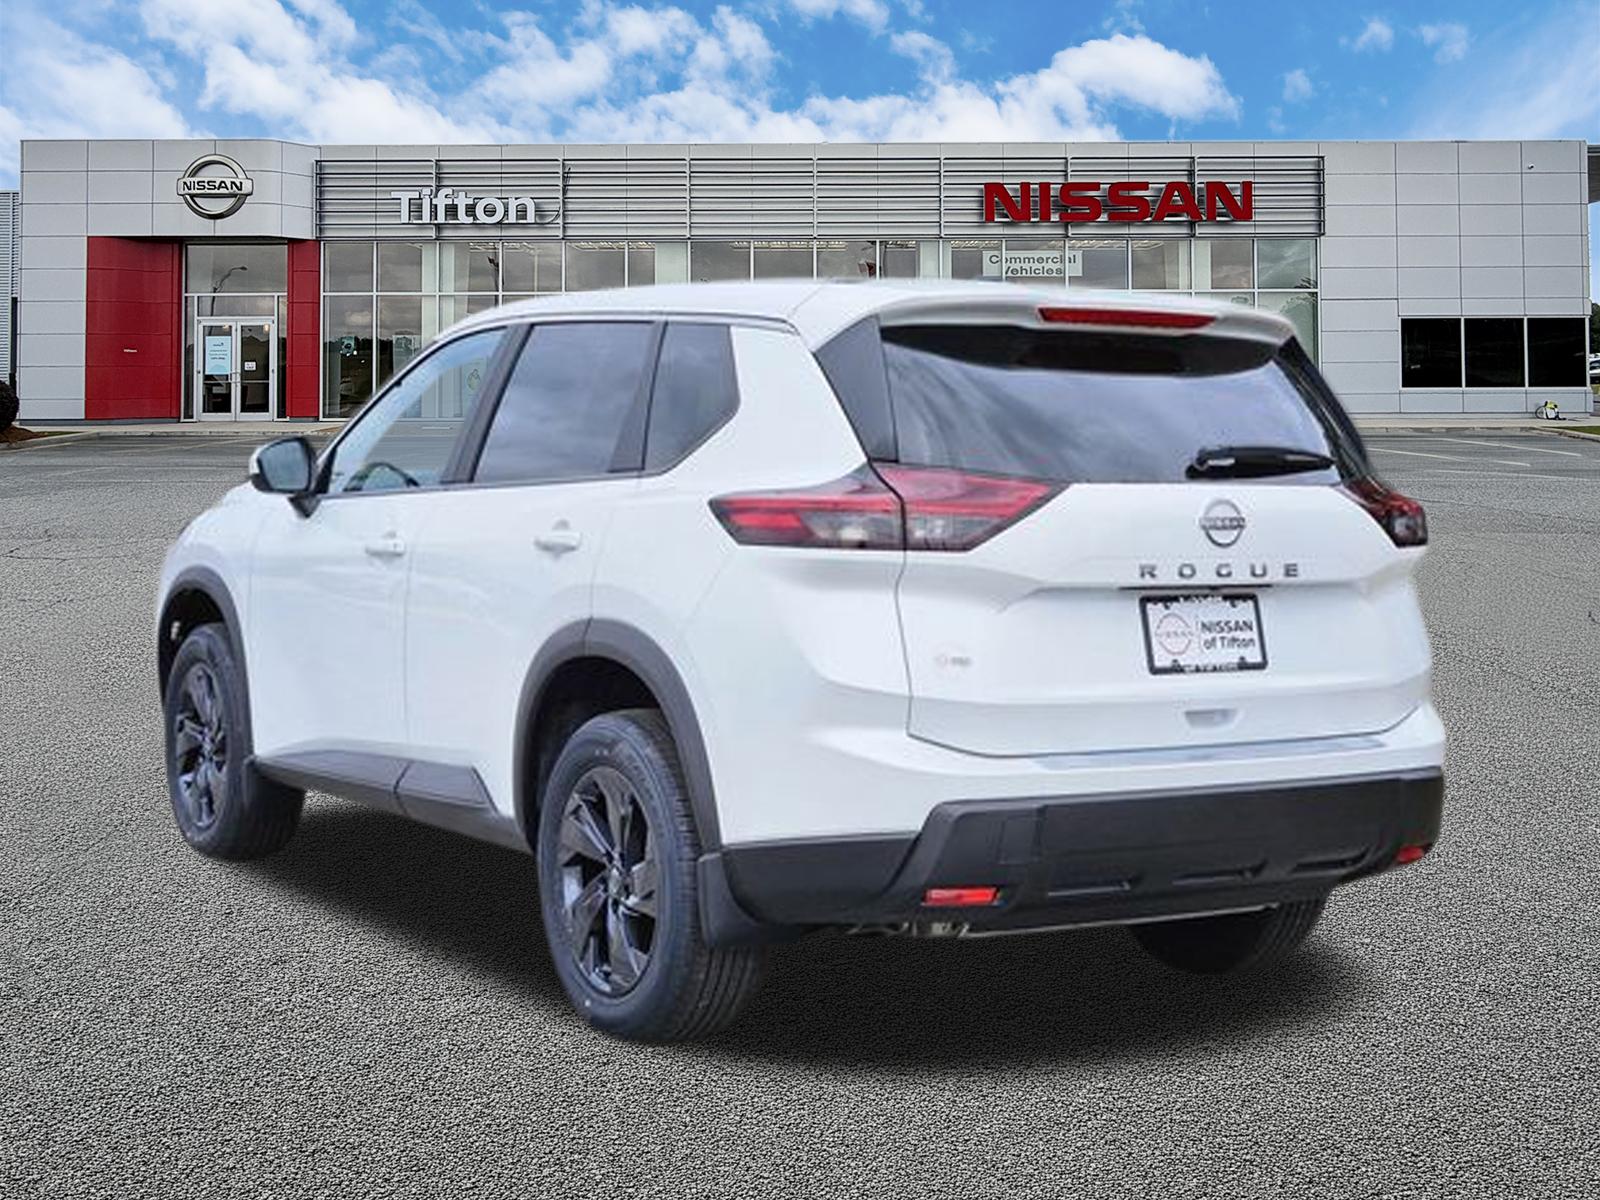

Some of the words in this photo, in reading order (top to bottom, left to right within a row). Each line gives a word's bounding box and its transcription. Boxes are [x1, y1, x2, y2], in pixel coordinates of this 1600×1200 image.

[183, 180, 243, 191] NISSAN
[390, 187, 536, 224] Tifton
[983, 181, 1253, 222] NISSAN
[1139, 562, 1299, 579] ROGUE
[1200, 620, 1254, 633] NISSAN
[1203, 636, 1217, 650] of
